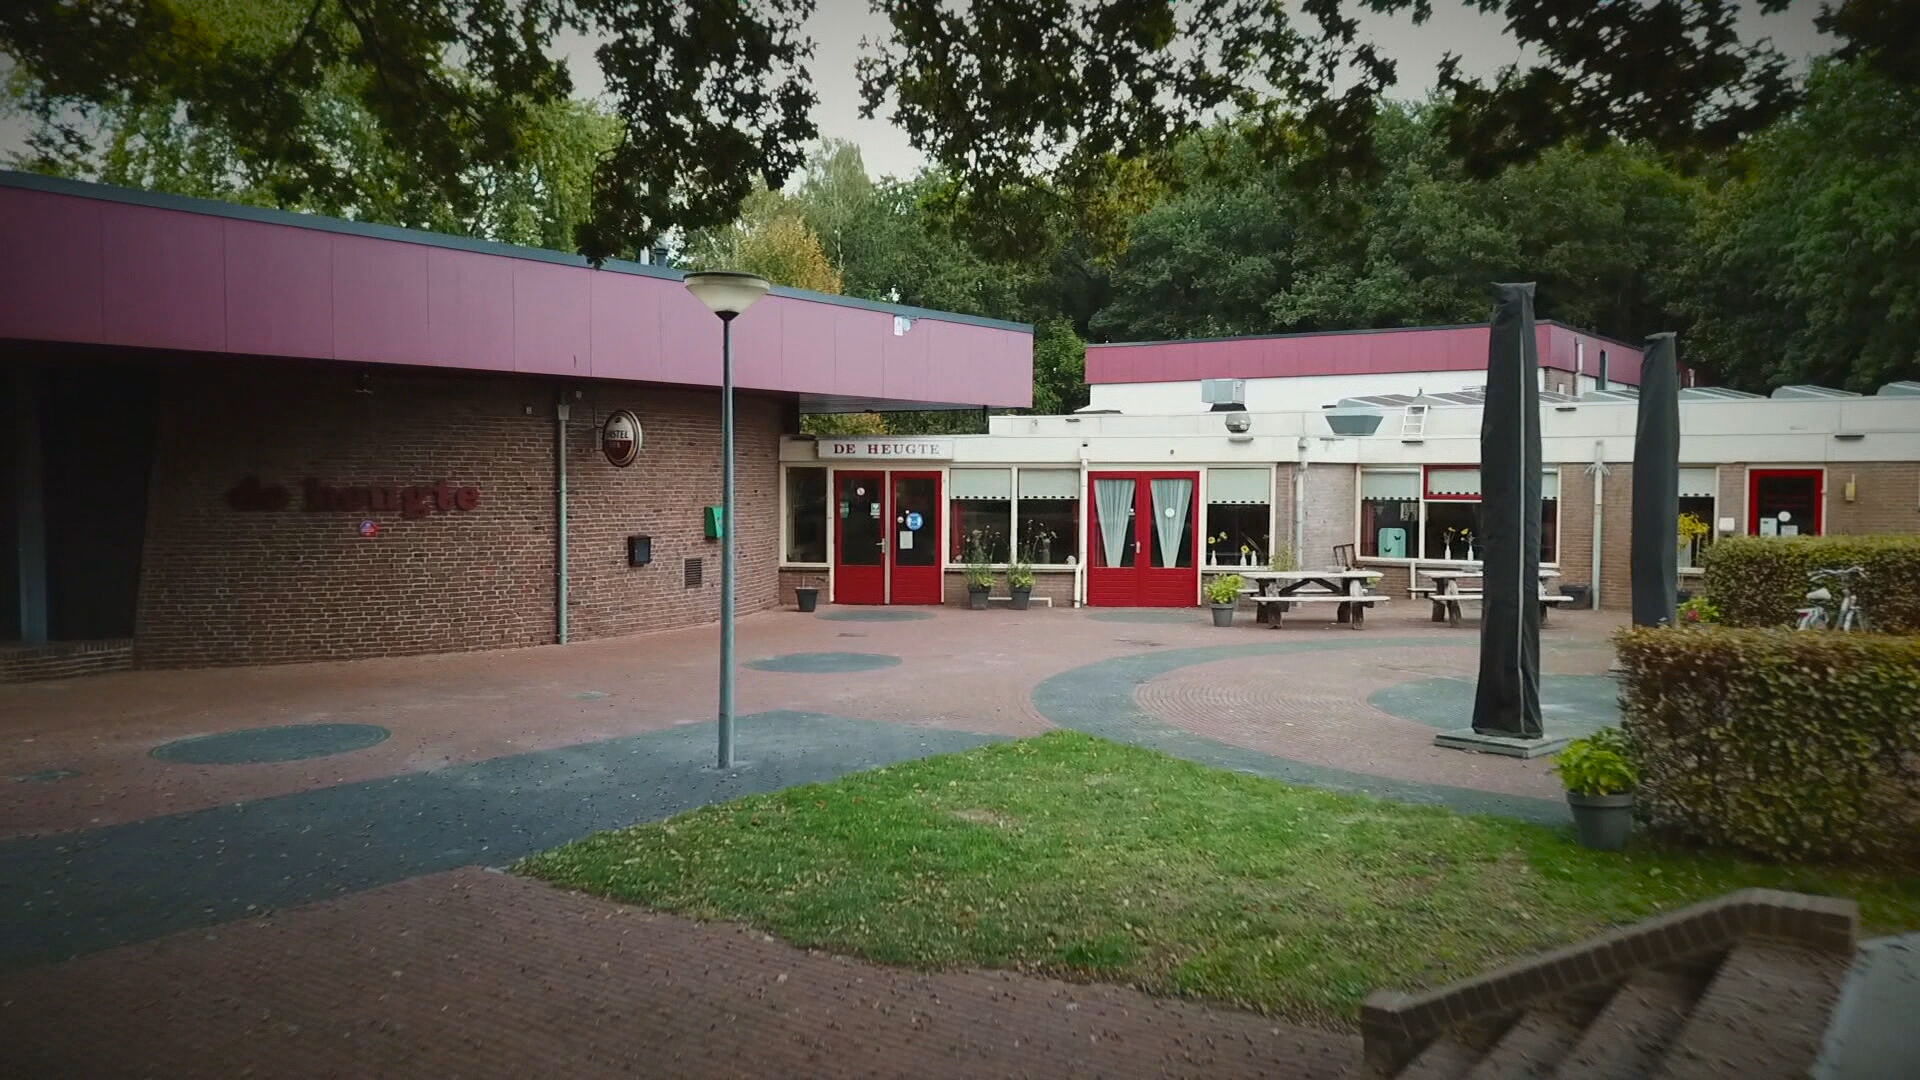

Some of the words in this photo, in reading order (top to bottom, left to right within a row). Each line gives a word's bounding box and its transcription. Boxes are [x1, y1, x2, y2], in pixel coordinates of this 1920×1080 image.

[606, 430, 629, 439] STEL
[834, 444, 856, 454] DE
[867, 444, 940, 455] HEUGTE
